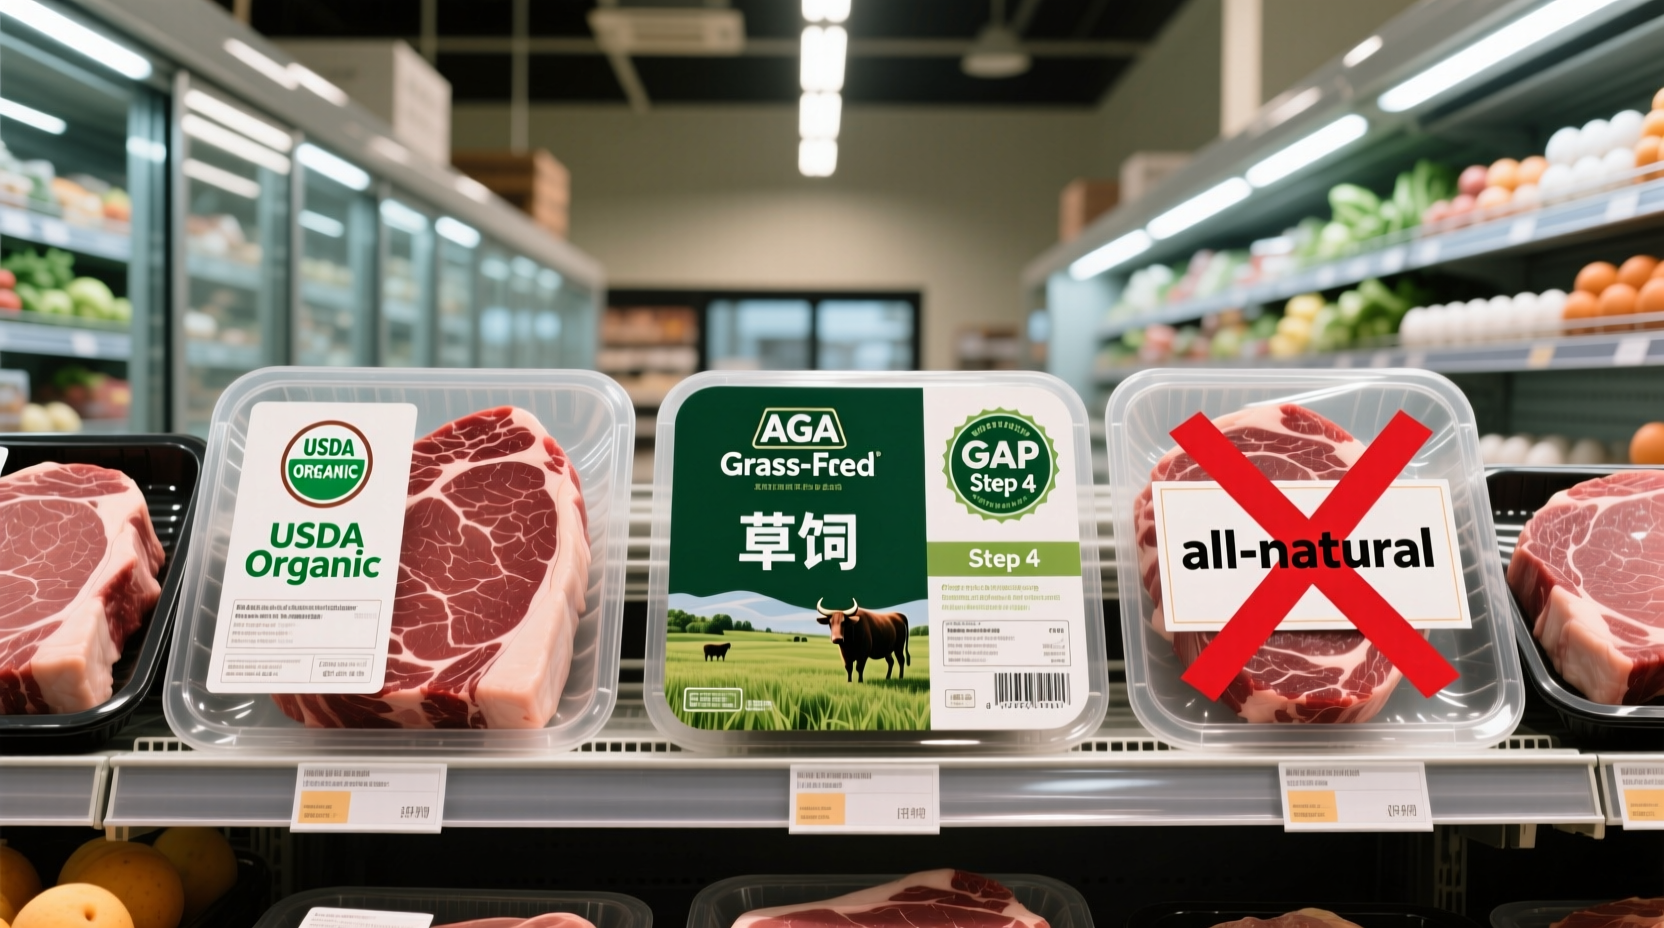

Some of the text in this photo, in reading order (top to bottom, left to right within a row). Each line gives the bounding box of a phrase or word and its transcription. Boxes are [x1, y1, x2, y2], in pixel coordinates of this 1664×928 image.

[759, 413, 840, 443] AGA
[303, 437, 355, 457] USDA
[961, 439, 1040, 470] GAP
[292, 464, 360, 480] ORGANIC
[970, 472, 1037, 498] Step 4
[270, 522, 365, 549] USDA
[738, 511, 857, 571] 草饲
[1182, 527, 1436, 571] all-natural
[245, 549, 382, 586] Organic
[968, 548, 1041, 573] Step 4
